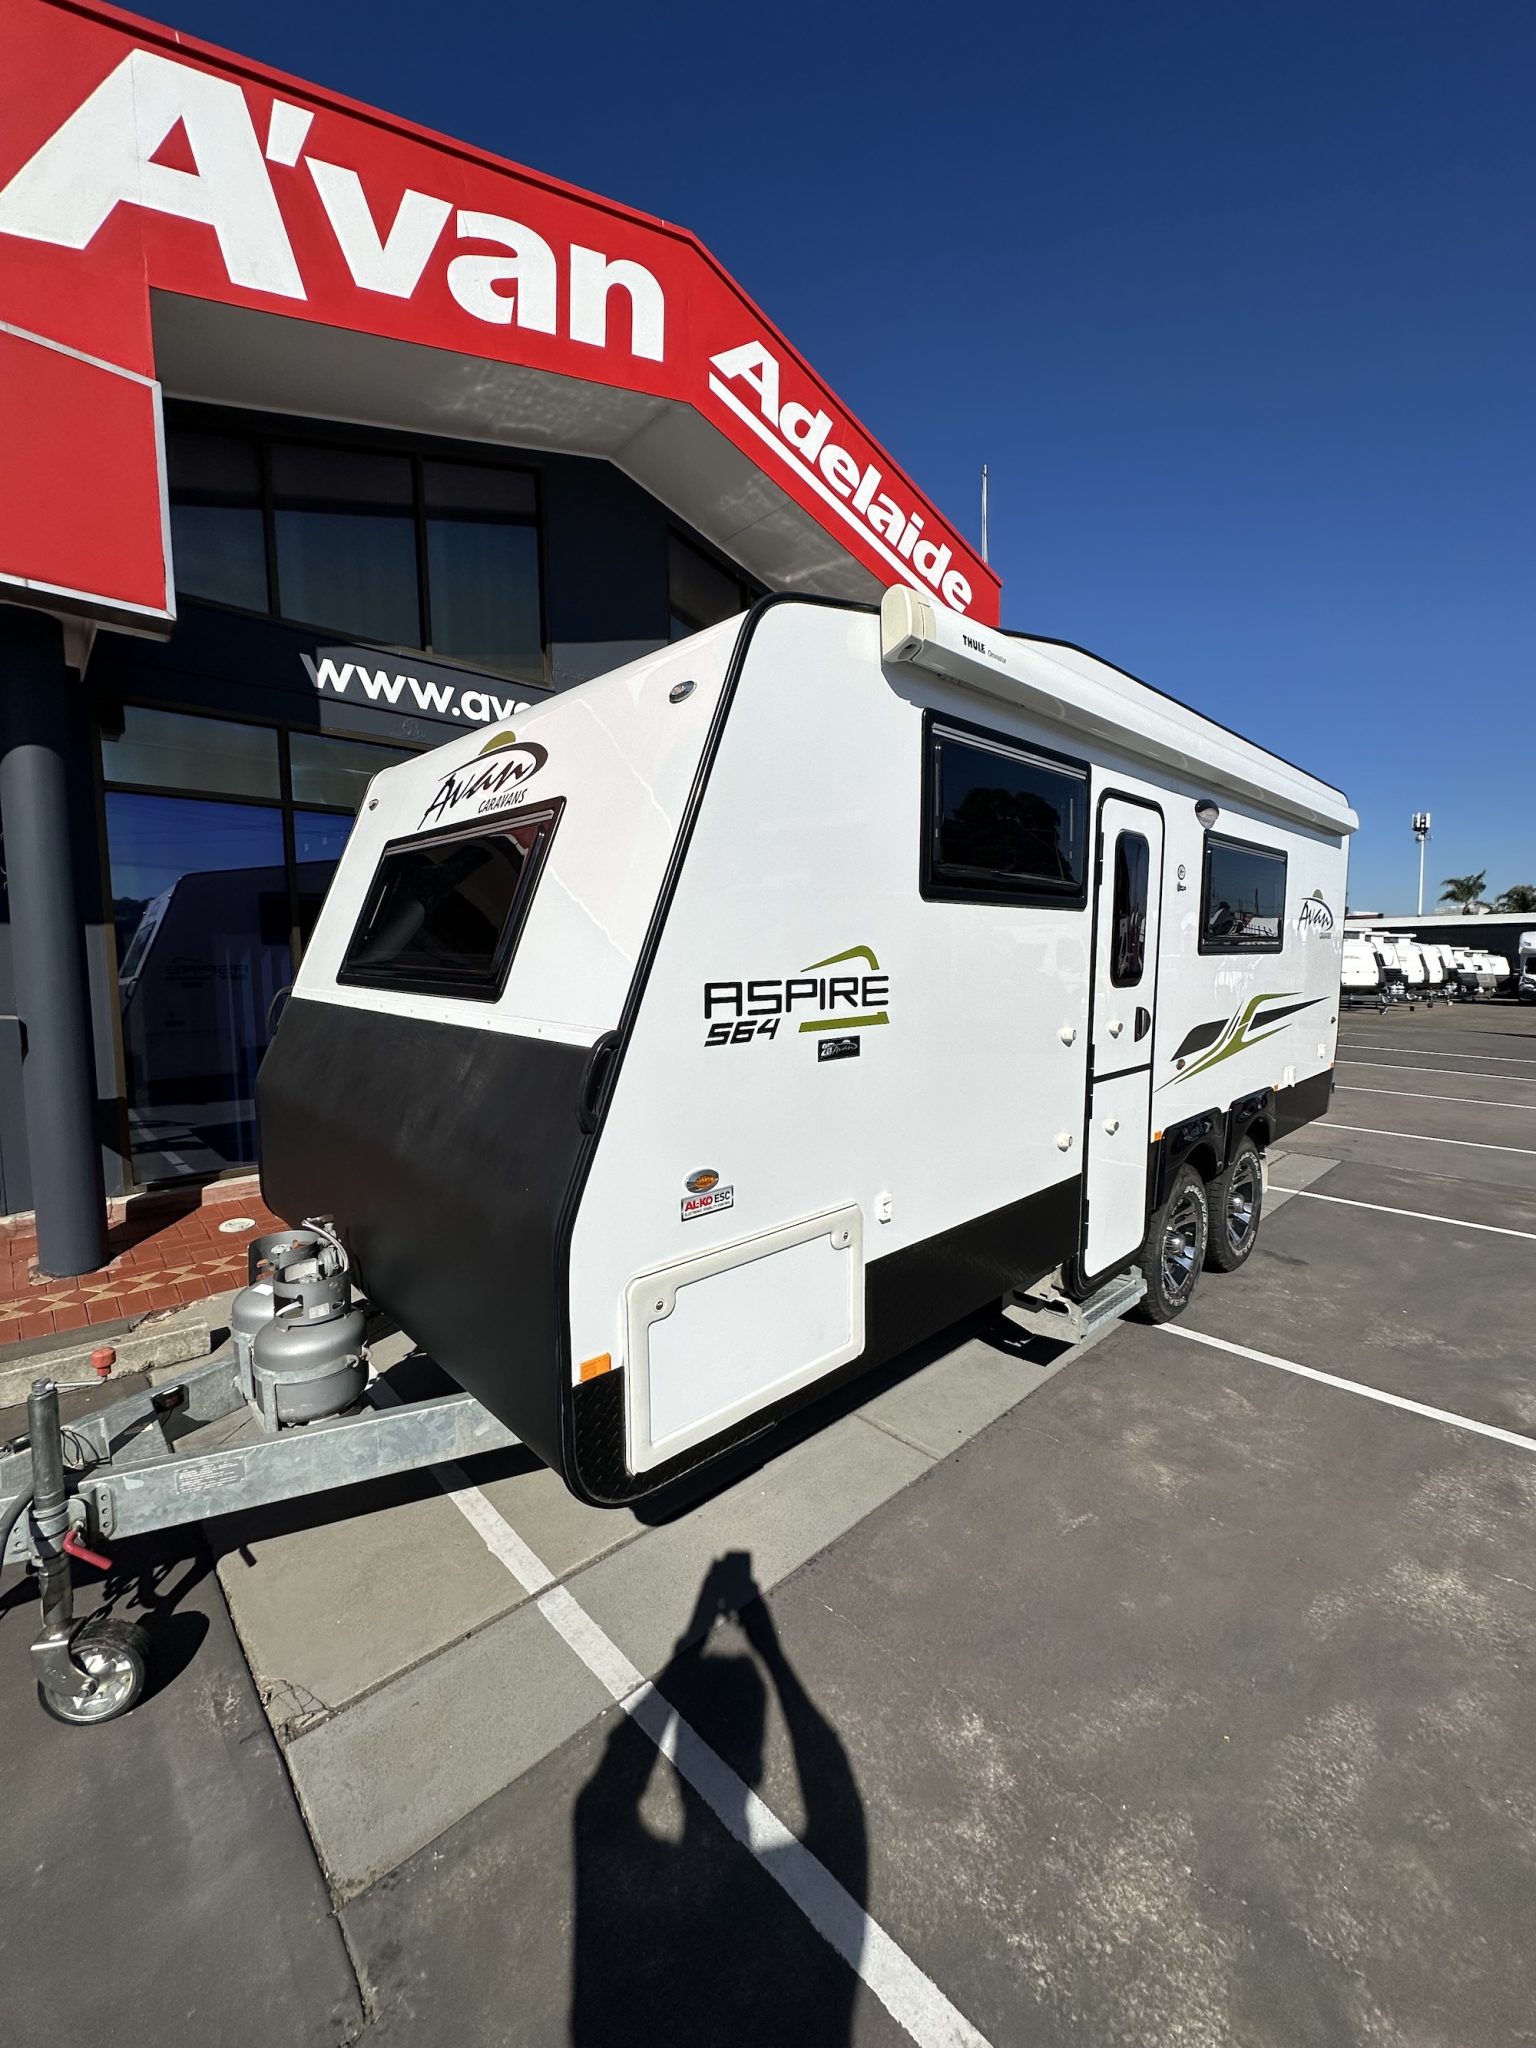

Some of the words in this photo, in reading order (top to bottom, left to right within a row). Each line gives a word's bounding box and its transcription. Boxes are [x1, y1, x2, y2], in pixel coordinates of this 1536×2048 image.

[0, 48, 665, 363] A'van
[708, 339, 973, 614] Adelaide
[962, 634, 985, 654] THULE
[477, 788, 529, 815] CARAVANS
[704, 975, 890, 1020] ASPIRE
[703, 1017, 782, 1048] 564
[714, 1191, 730, 1203] ESC
